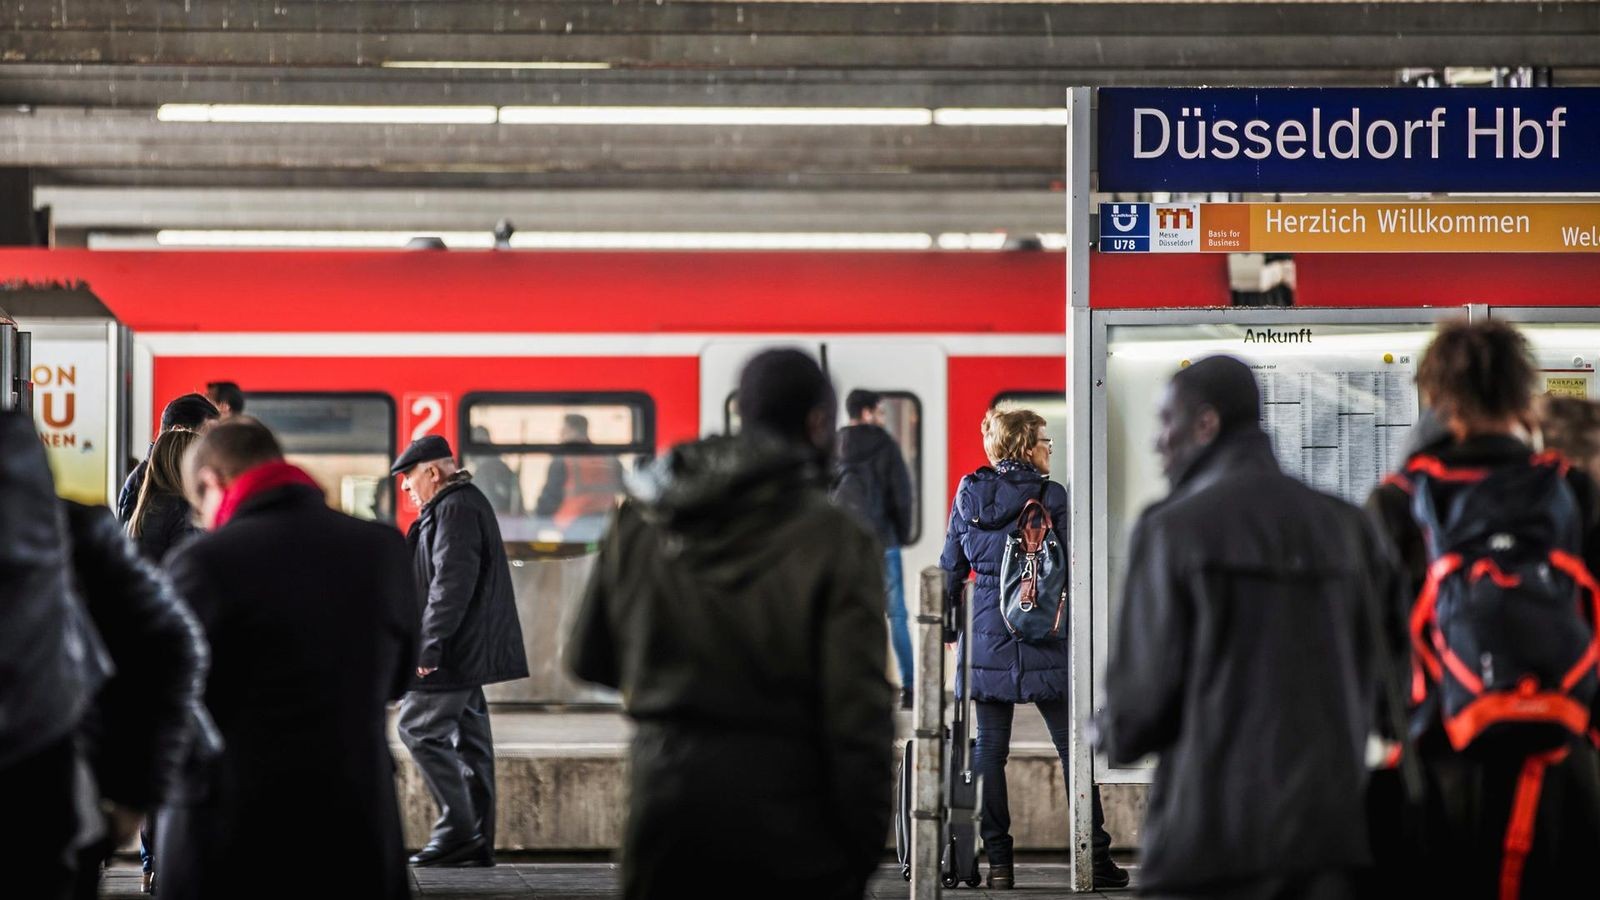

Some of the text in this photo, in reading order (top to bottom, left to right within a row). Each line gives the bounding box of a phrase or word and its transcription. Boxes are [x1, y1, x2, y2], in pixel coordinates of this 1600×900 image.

[1133, 107, 1567, 160] Düsseldorf Hbf
[1266, 208, 1530, 234] Herzlich Willkommen
[1158, 231, 1179, 239] Messe
[1158, 239, 1194, 247] Düsseldorf
[1208, 230, 1241, 238] Basis for
[1562, 225, 1600, 247] Wel
[1113, 239, 1136, 250] U78
[1244, 328, 1312, 344] Ankunft
[32, 366, 76, 386] ON
[42, 392, 75, 429] U
[411, 395, 442, 441] 2
